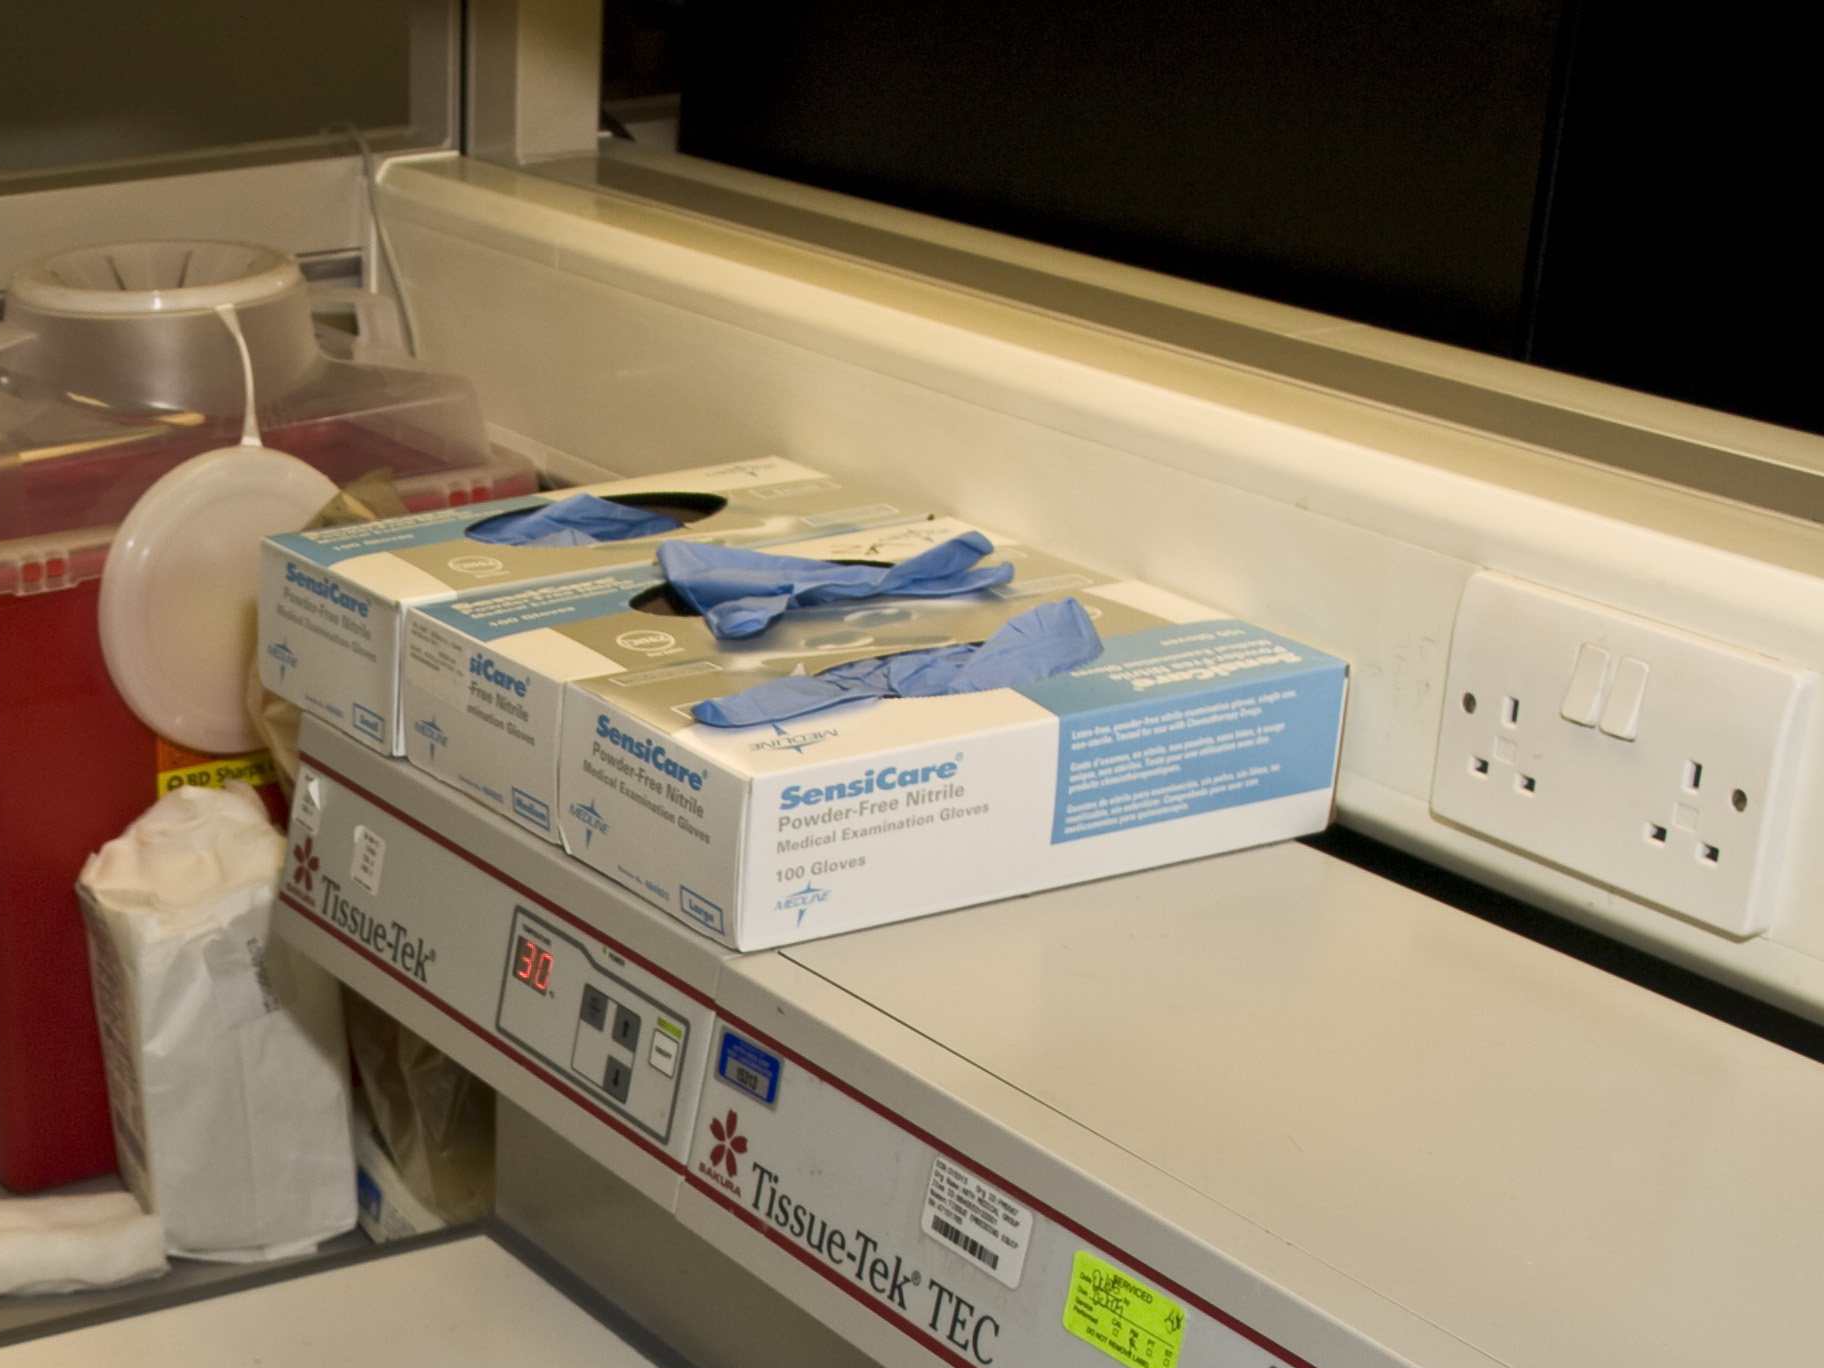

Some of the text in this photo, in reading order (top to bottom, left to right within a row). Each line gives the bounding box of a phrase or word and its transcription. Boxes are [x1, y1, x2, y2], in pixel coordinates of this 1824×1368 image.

[187, 771, 211, 786] BD
[582, 759, 711, 845] Medical Examination Gloves
[592, 741, 704, 819] Powder-Free Nitrile
[776, 802, 990, 855] Medical Examination Gloves
[778, 783, 965, 833] Powder-Free Nitrile
[776, 855, 867, 883] 100 Gloves
[773, 888, 832, 912] MEDLINE
[516, 940, 554, 990] 30
[698, 1161, 742, 1199] SAKURA
[928, 1278, 1000, 1366] TEC
[1086, 1325, 1096, 1337] DO
[1096, 1332, 1108, 1342] NOT
